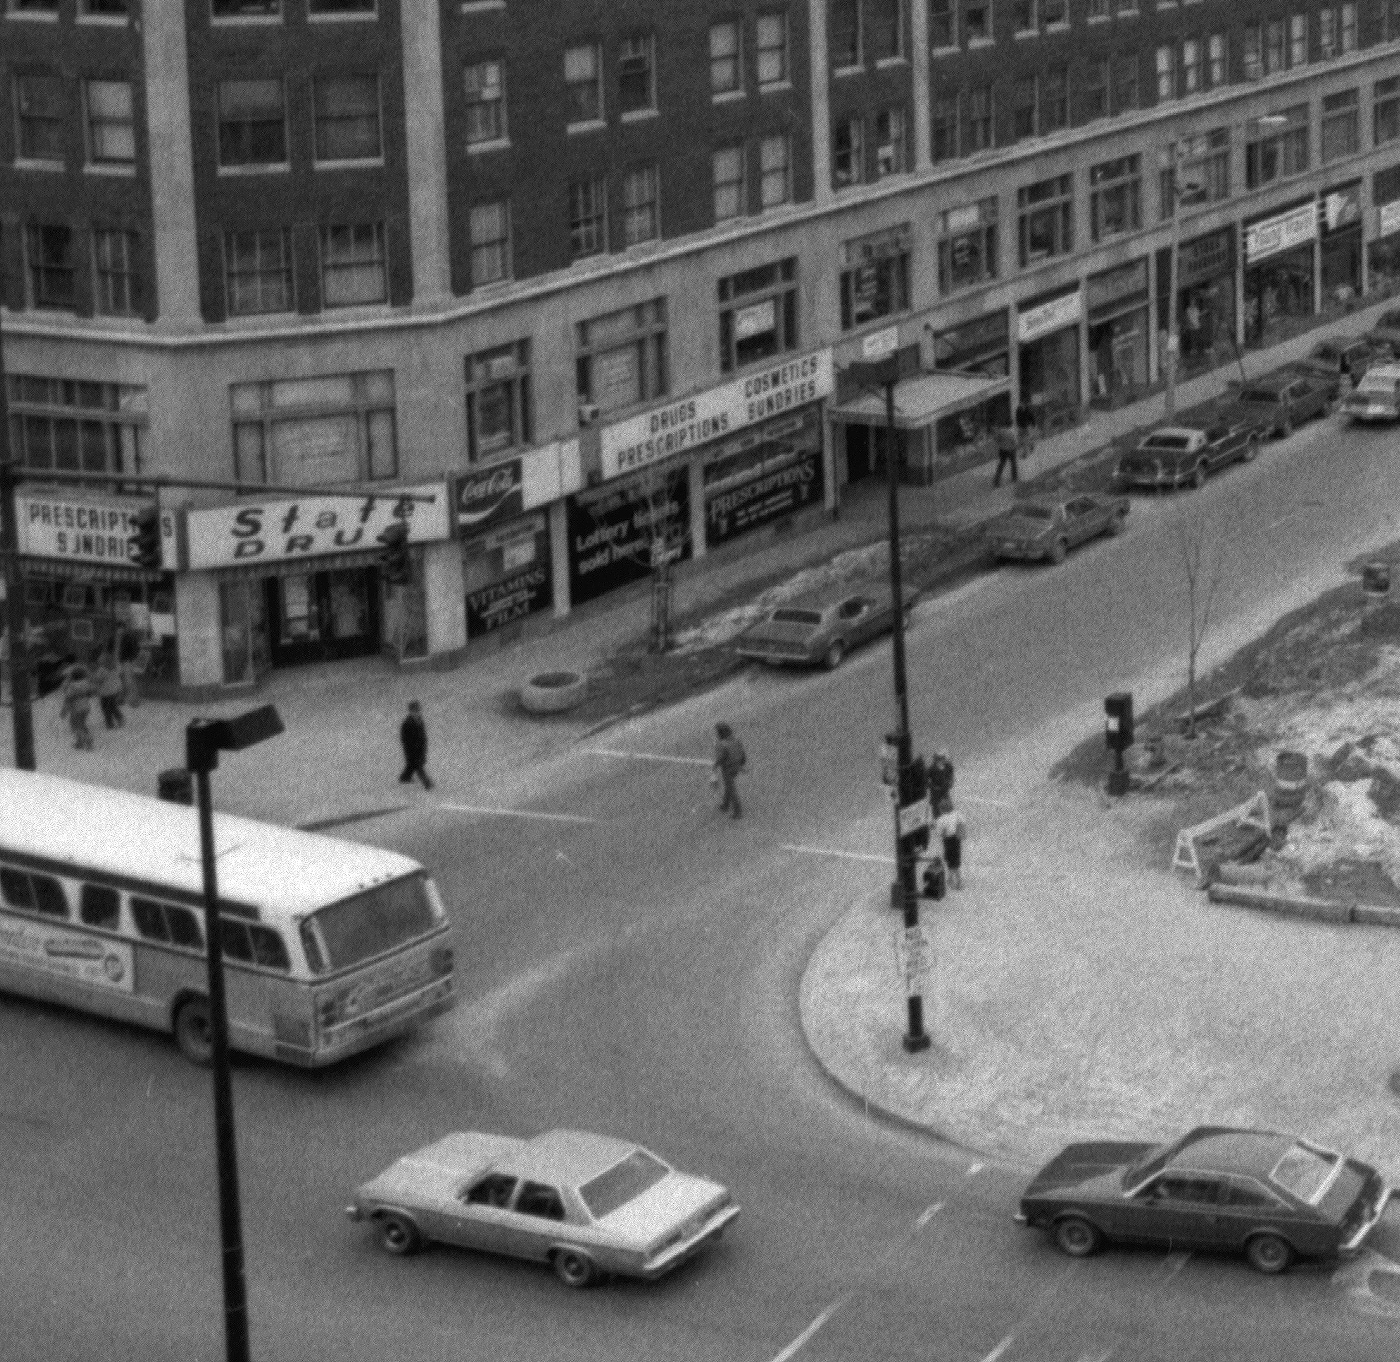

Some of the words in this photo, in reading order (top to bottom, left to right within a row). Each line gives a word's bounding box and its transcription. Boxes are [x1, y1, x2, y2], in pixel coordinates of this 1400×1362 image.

[746, 356, 818, 398] COSMETICS
[650, 401, 696, 433] DRUGS
[748, 380, 816, 420] SUNDRIES
[617, 412, 729, 469] PRESCRIPTIONS
[710, 460, 815, 520] PRESCRIPTIONS
[230, 495, 415, 537] State
[57, 531, 146, 560] SUNDRIE
[234, 526, 405, 559] DRU
[468, 568, 546, 609] VITAMINS
